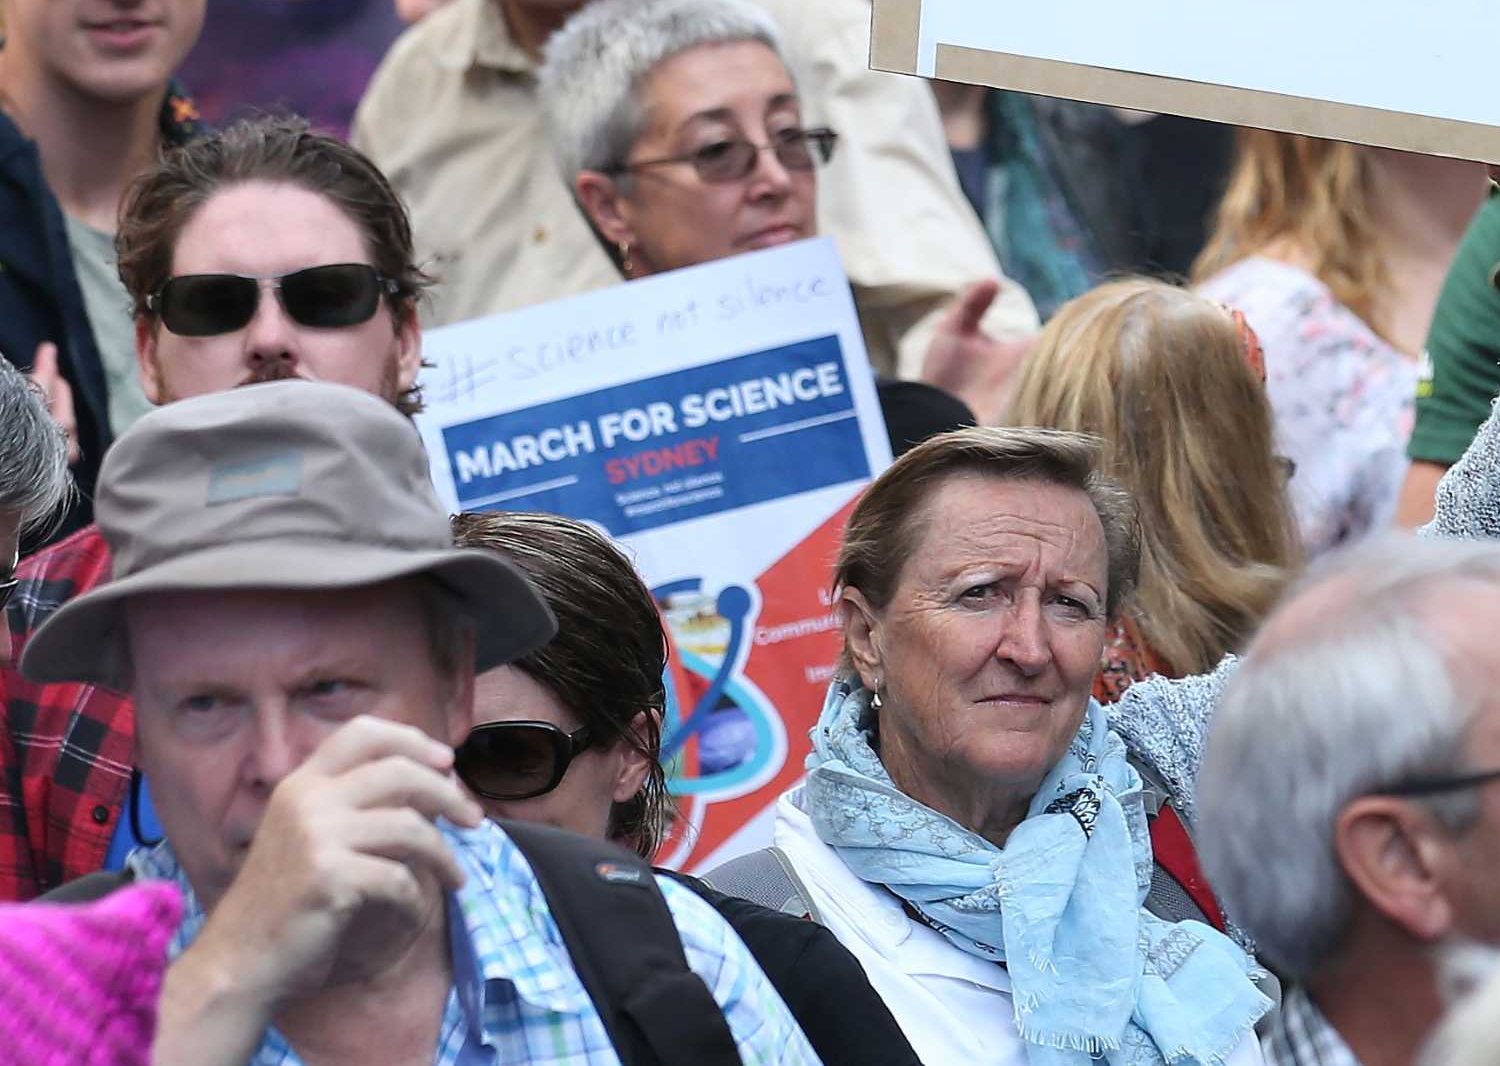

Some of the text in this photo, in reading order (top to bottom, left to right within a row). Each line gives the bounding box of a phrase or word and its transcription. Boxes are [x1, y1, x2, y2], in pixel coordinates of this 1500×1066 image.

[456, 361, 844, 484] MARCH FOR SCIENCE
[605, 435, 721, 485] SYDNEY
